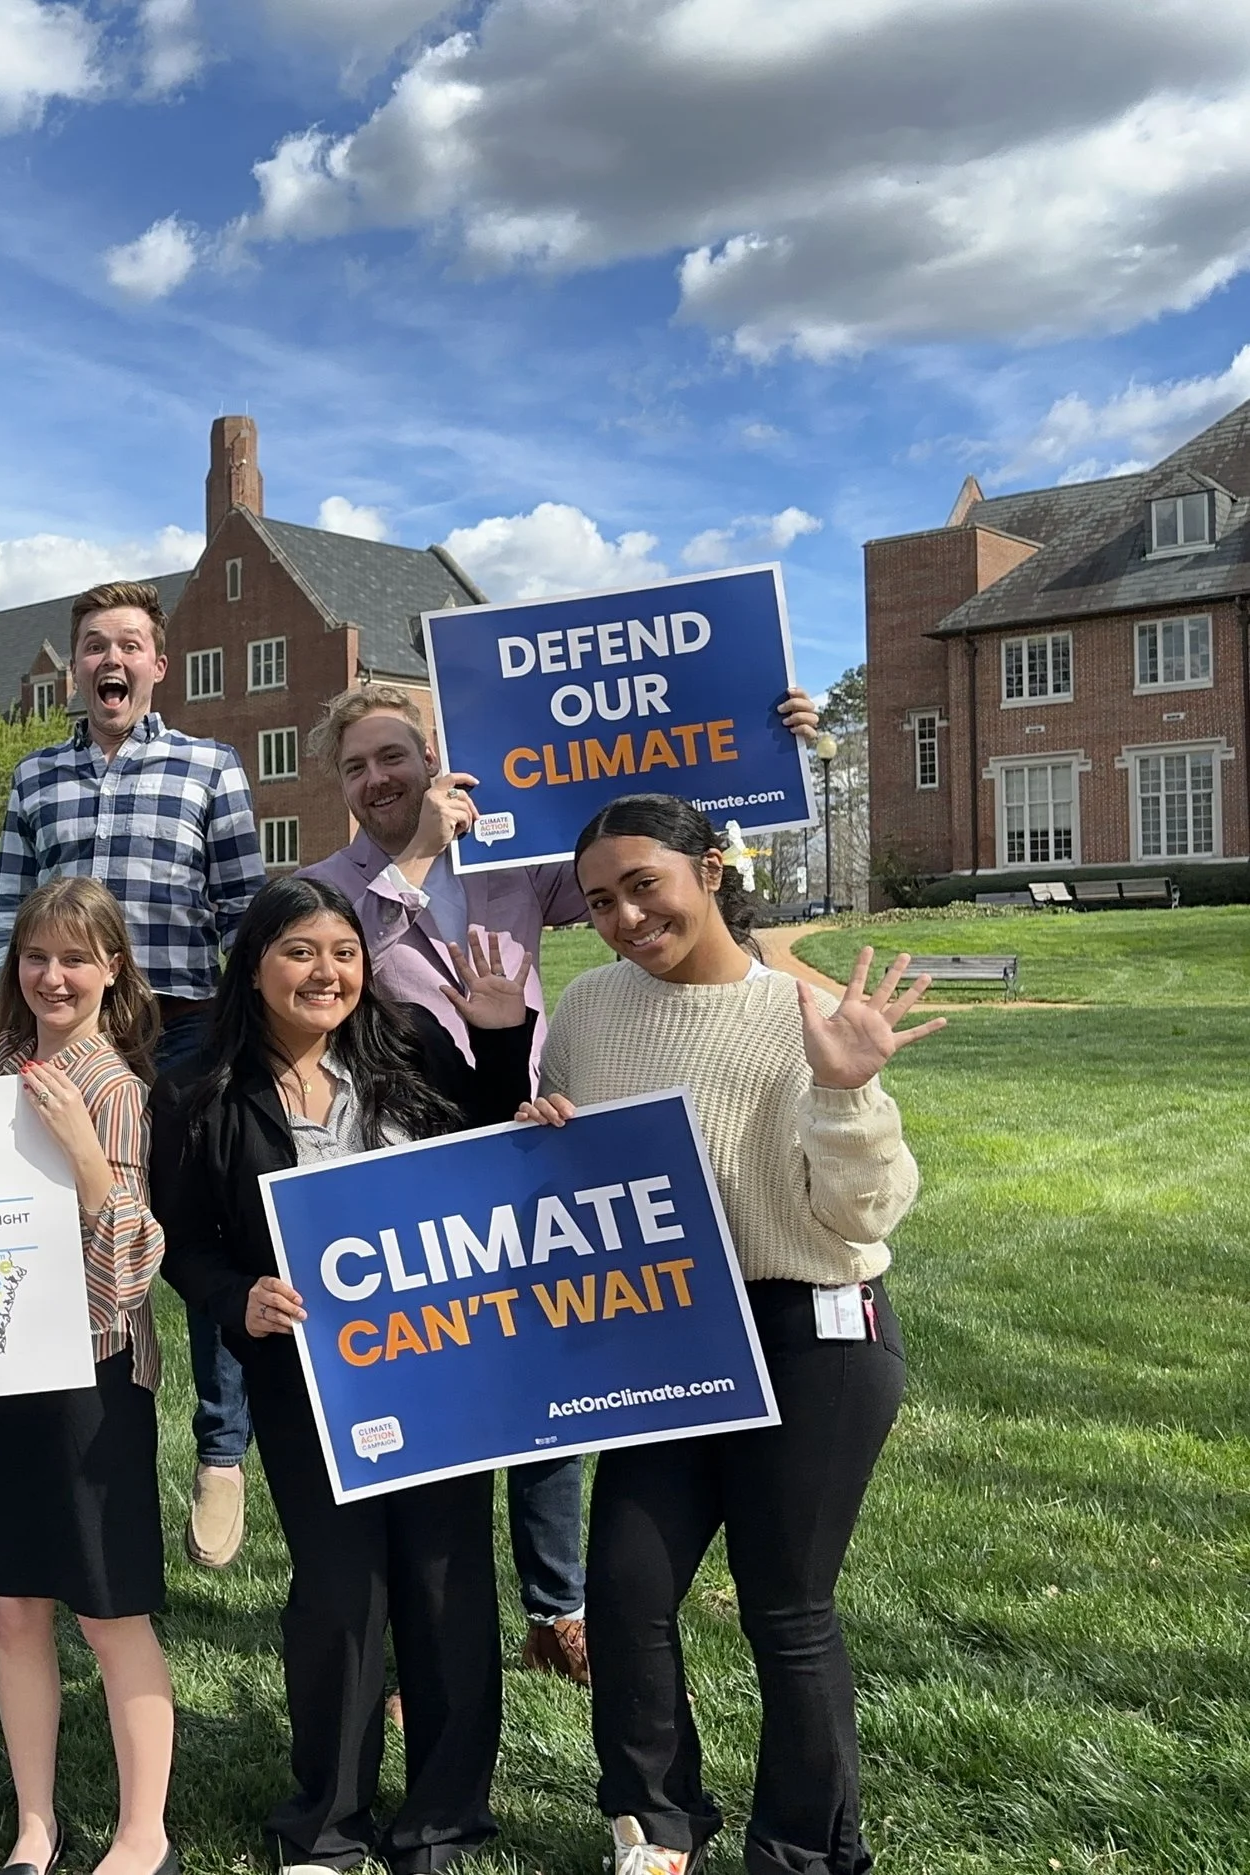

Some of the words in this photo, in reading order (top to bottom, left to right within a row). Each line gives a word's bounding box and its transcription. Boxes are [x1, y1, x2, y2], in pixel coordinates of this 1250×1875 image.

[497, 611, 711, 679] DEFEND
[550, 673, 671, 727] OUR
[503, 719, 738, 789] CLIMATE
[691, 790, 785, 812] limate.com
[480, 817, 508, 825] CLIMATE
[481, 823, 509, 831] ACTION
[320, 1174, 685, 1302] CLIMATE
[337, 1288, 519, 1368] CAN'T
[530, 1257, 695, 1329] WAIT
[548, 1377, 735, 1419] ActOnClimate.com
[359, 1422, 393, 1436] CLIMATE
[361, 1431, 395, 1444] ACTION
[362, 1439, 397, 1451] CAMPAIGN
